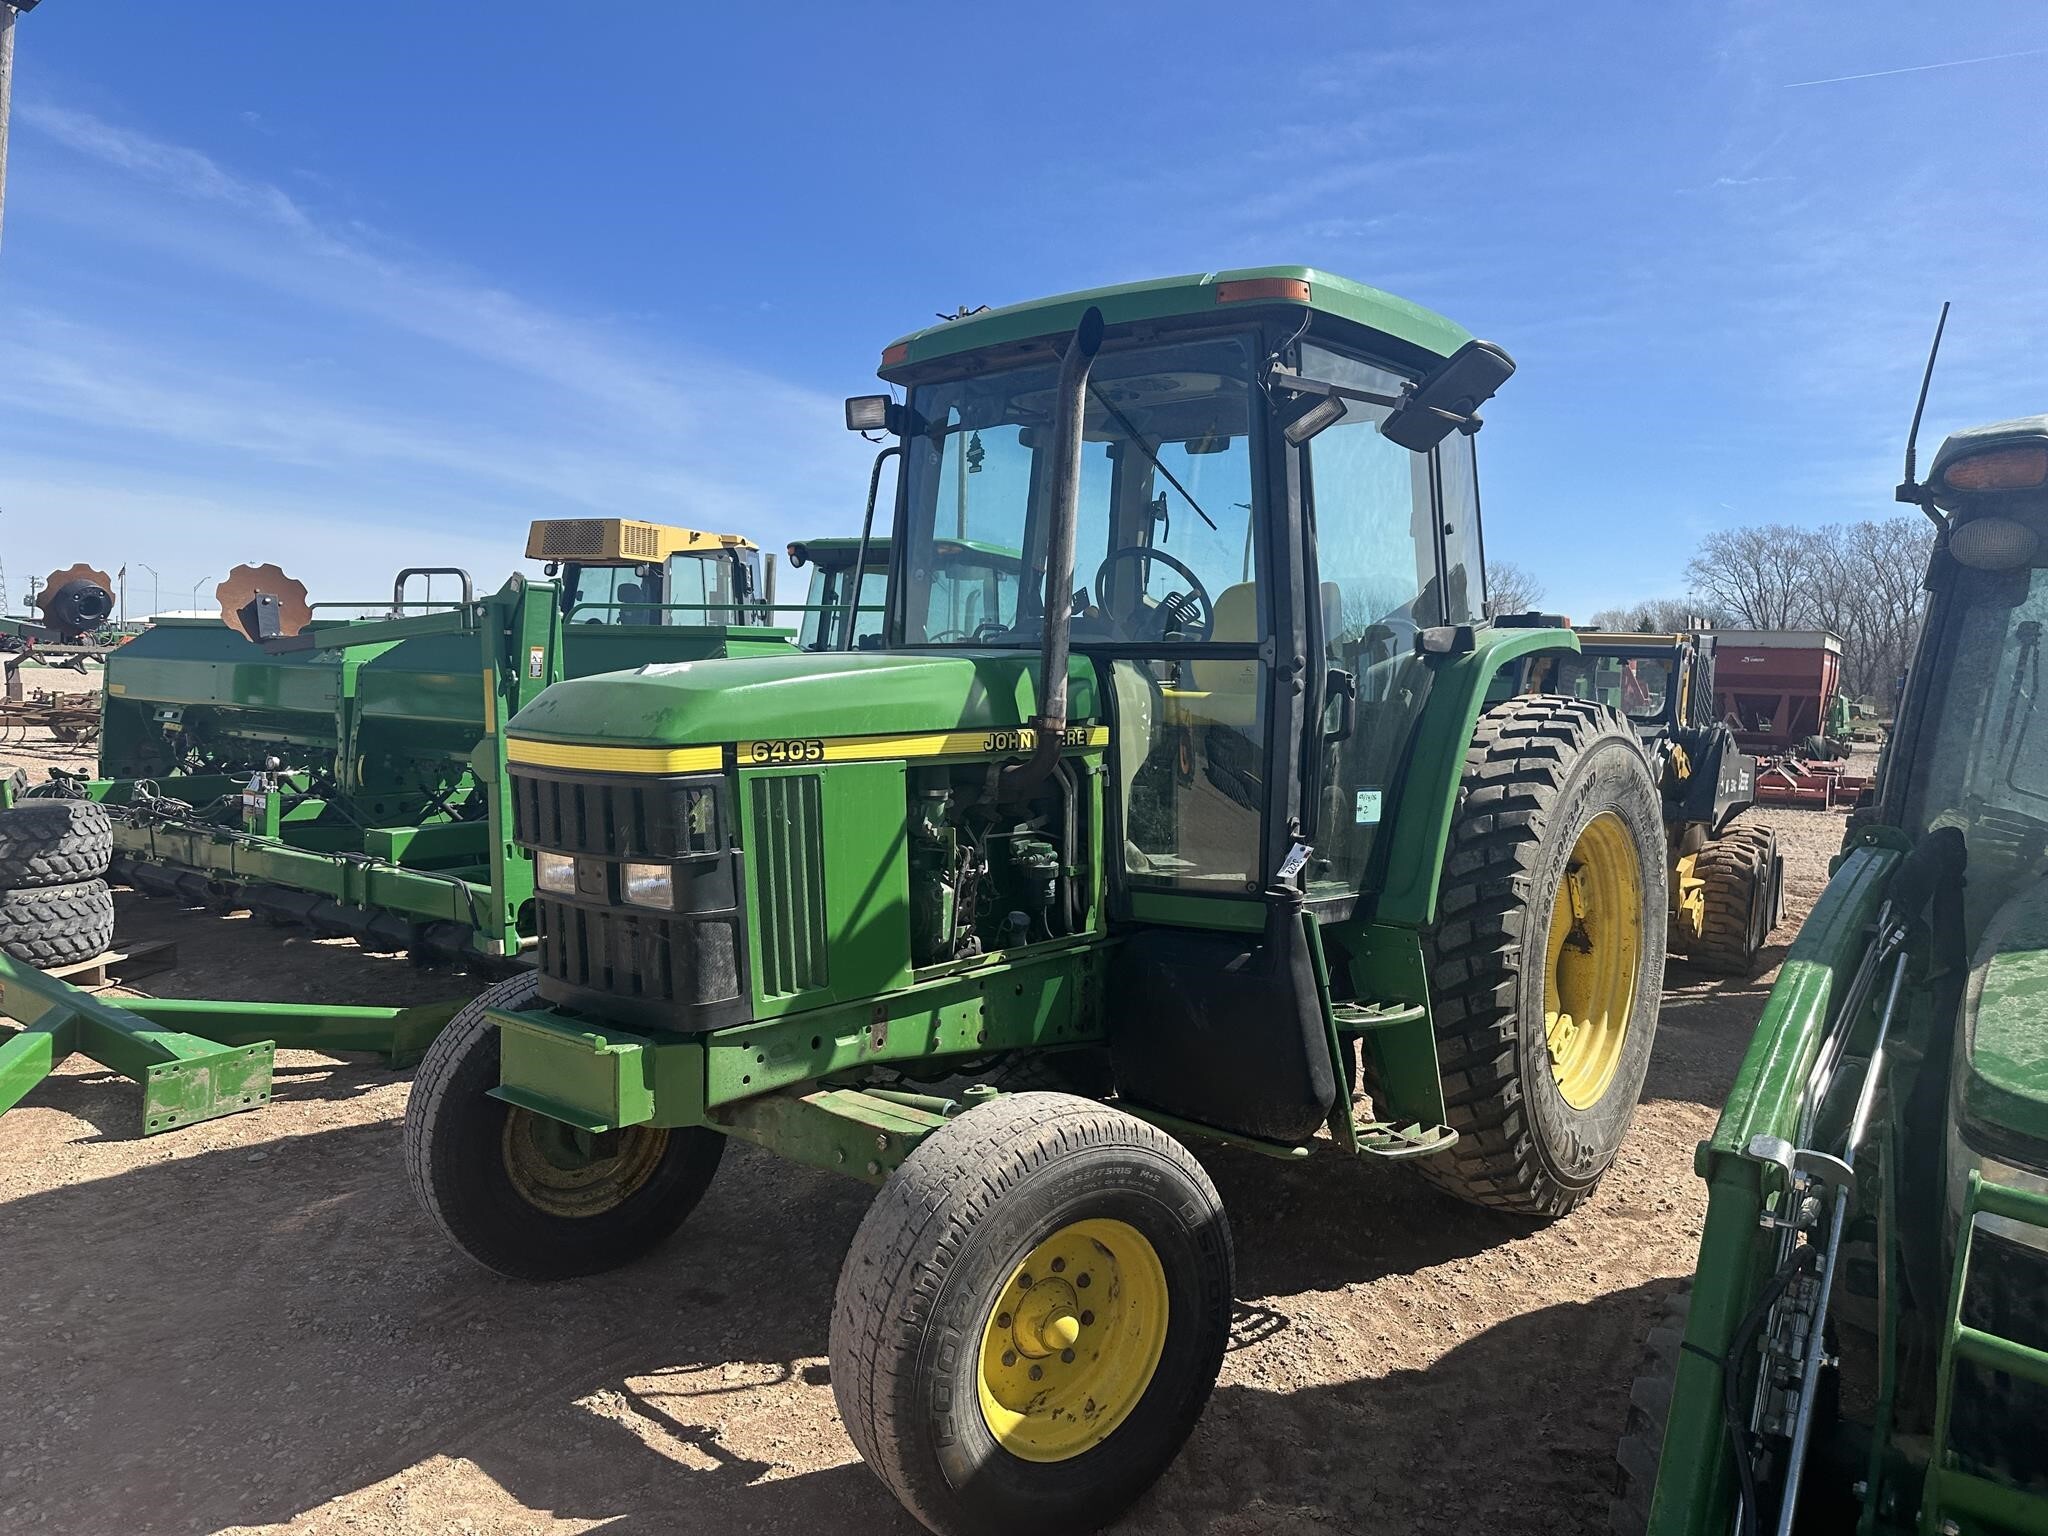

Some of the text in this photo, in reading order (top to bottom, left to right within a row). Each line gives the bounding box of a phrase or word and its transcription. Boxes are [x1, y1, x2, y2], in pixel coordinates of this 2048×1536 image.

[752, 741, 824, 762] 6405
[984, 732, 1032, 751] JOHN
[1579, 771, 1597, 801] IND
[1285, 858, 1303, 875] 3222
